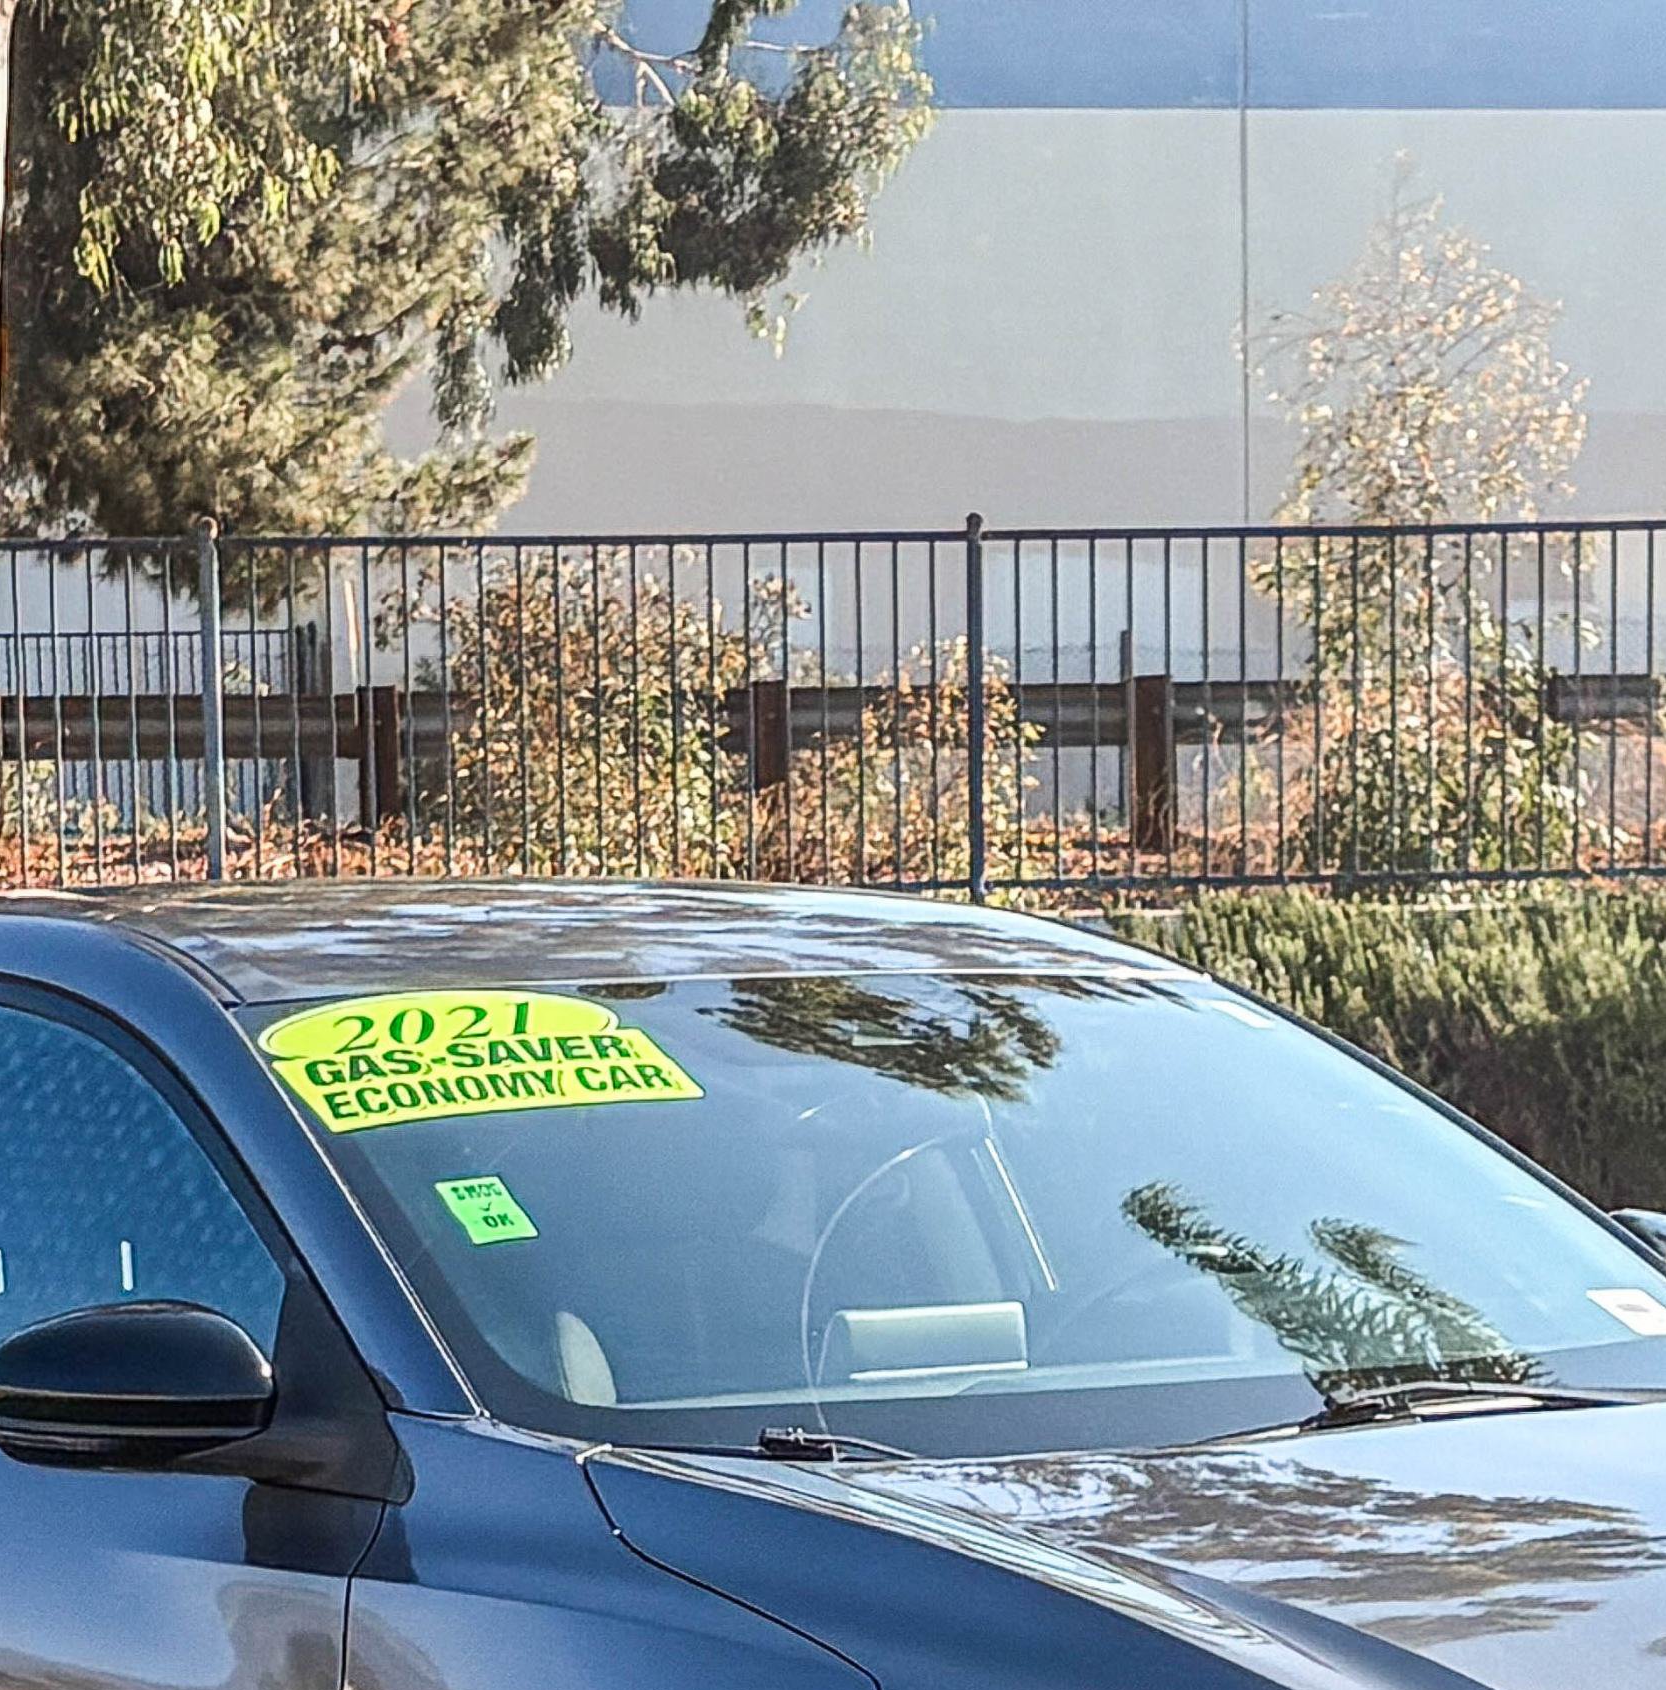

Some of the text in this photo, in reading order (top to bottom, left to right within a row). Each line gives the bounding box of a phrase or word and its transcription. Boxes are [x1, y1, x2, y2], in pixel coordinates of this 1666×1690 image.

[333, 1001, 531, 1055] 2021
[322, 1064, 673, 1120] ECONOMY CAR
[481, 1212, 515, 1229] OK
